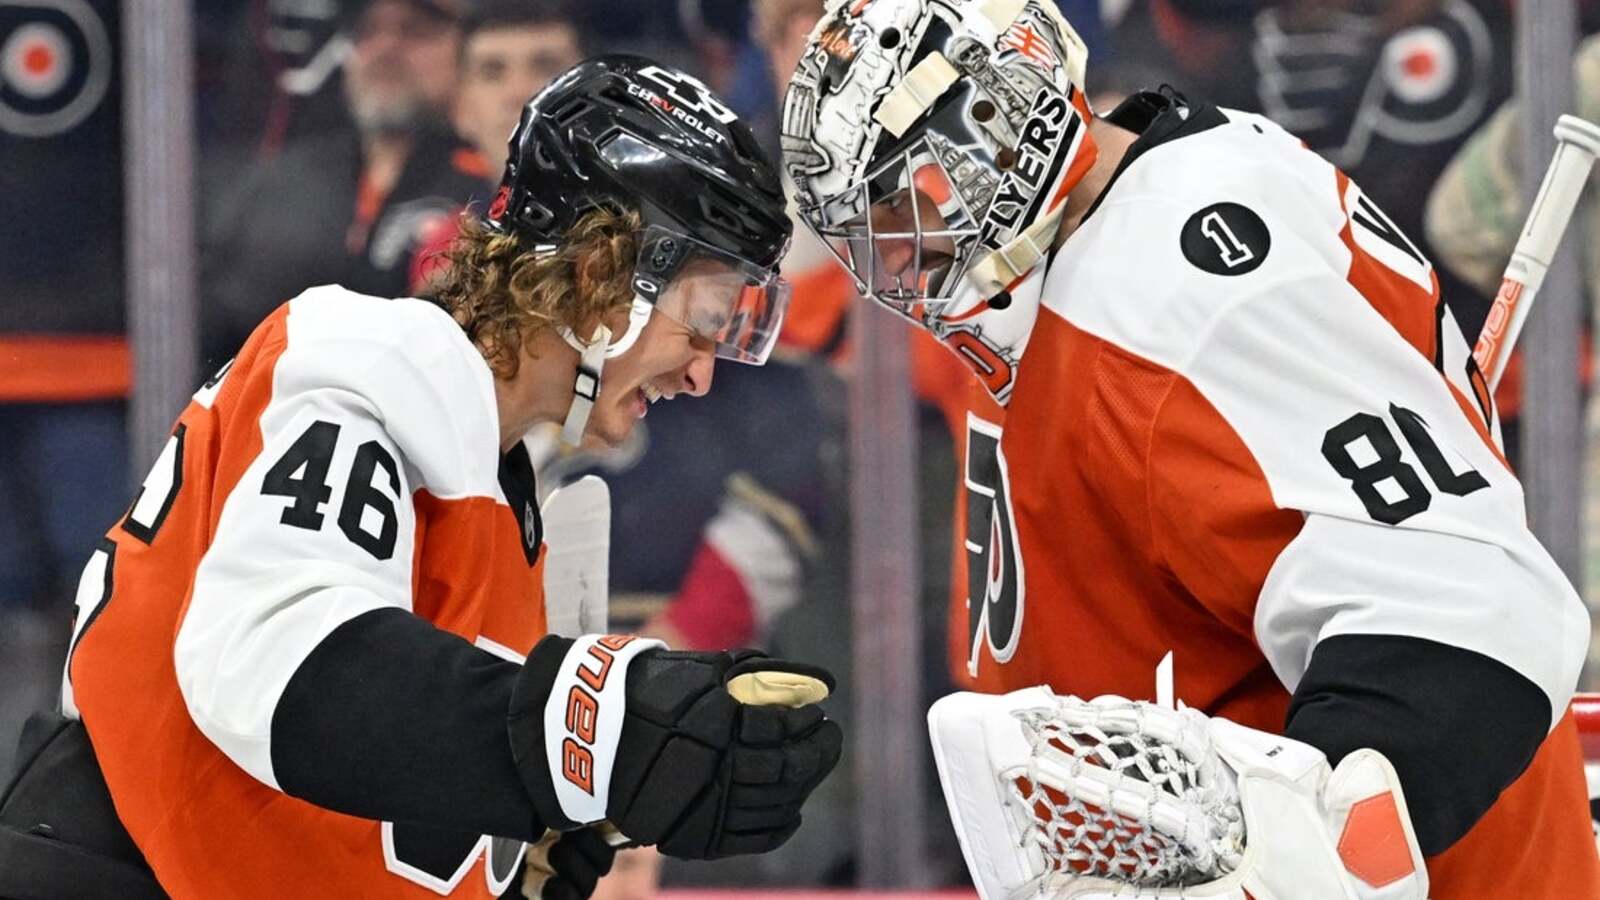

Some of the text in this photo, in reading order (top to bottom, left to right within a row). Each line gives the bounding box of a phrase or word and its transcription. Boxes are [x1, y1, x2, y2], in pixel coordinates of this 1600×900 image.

[627, 82, 726, 144] CHEVROLET
[980, 86, 1068, 251] FLYERS
[1202, 211, 1254, 268] 1
[260, 420, 401, 560] 46
